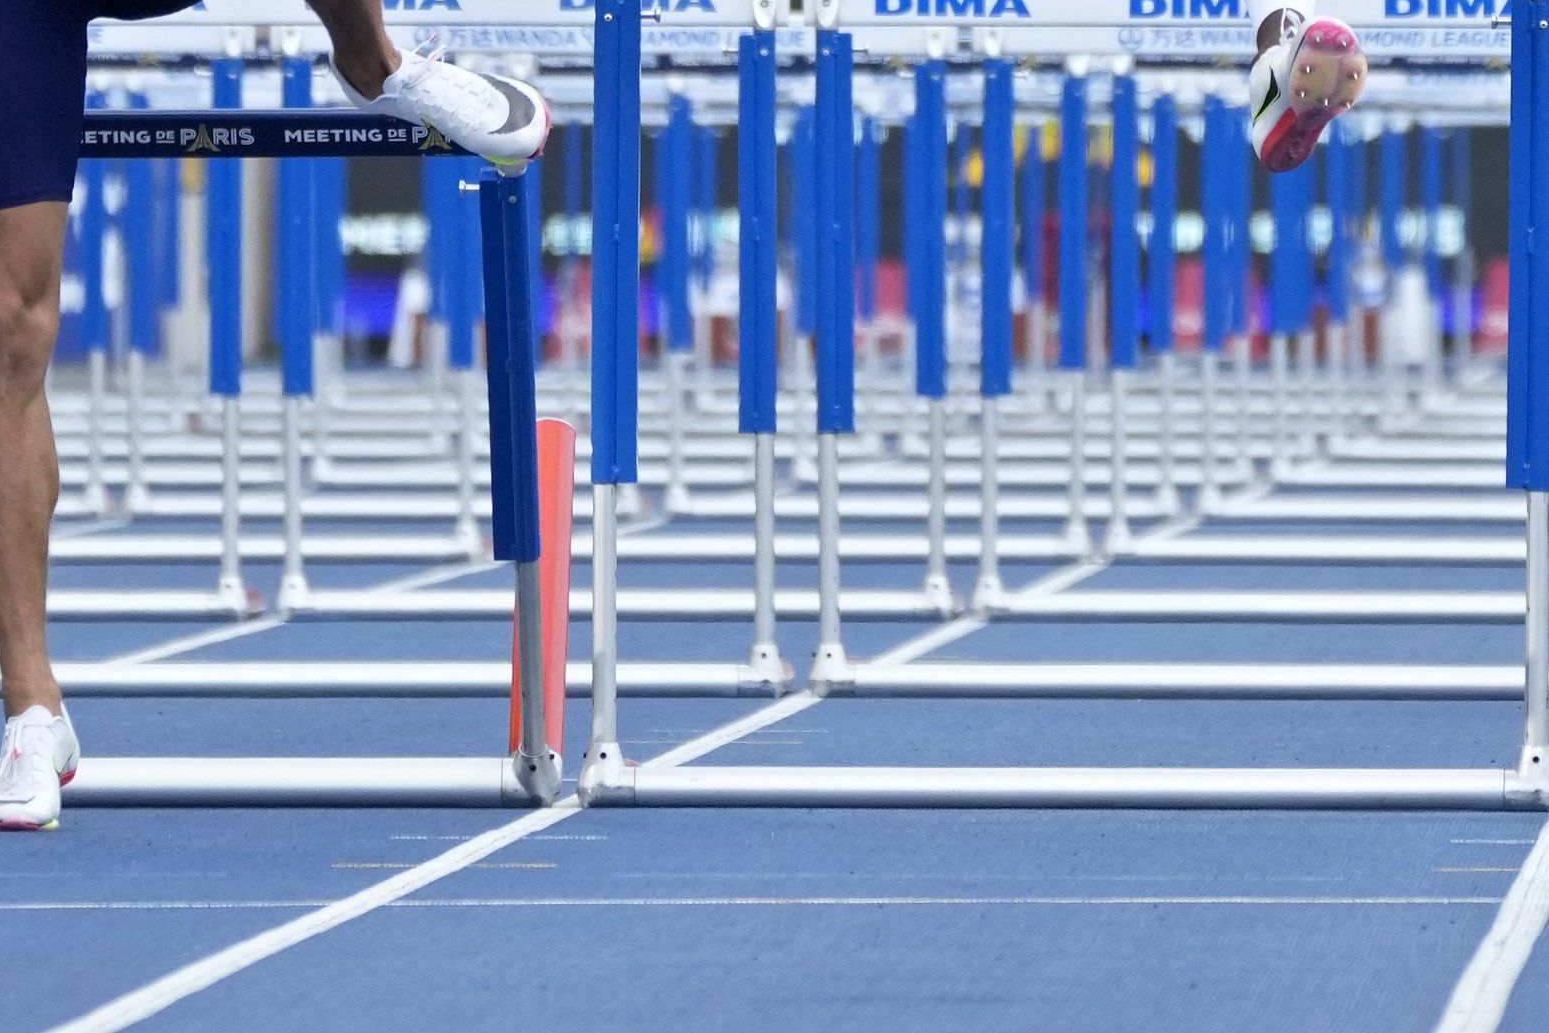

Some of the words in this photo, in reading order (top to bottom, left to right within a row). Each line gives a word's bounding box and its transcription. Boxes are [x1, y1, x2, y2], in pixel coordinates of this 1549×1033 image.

[82, 130, 151, 145] ETING
[155, 130, 175, 144] DE
[180, 123, 255, 153] PARIS
[284, 129, 382, 144] MEETING
[387, 129, 408, 143] DE
